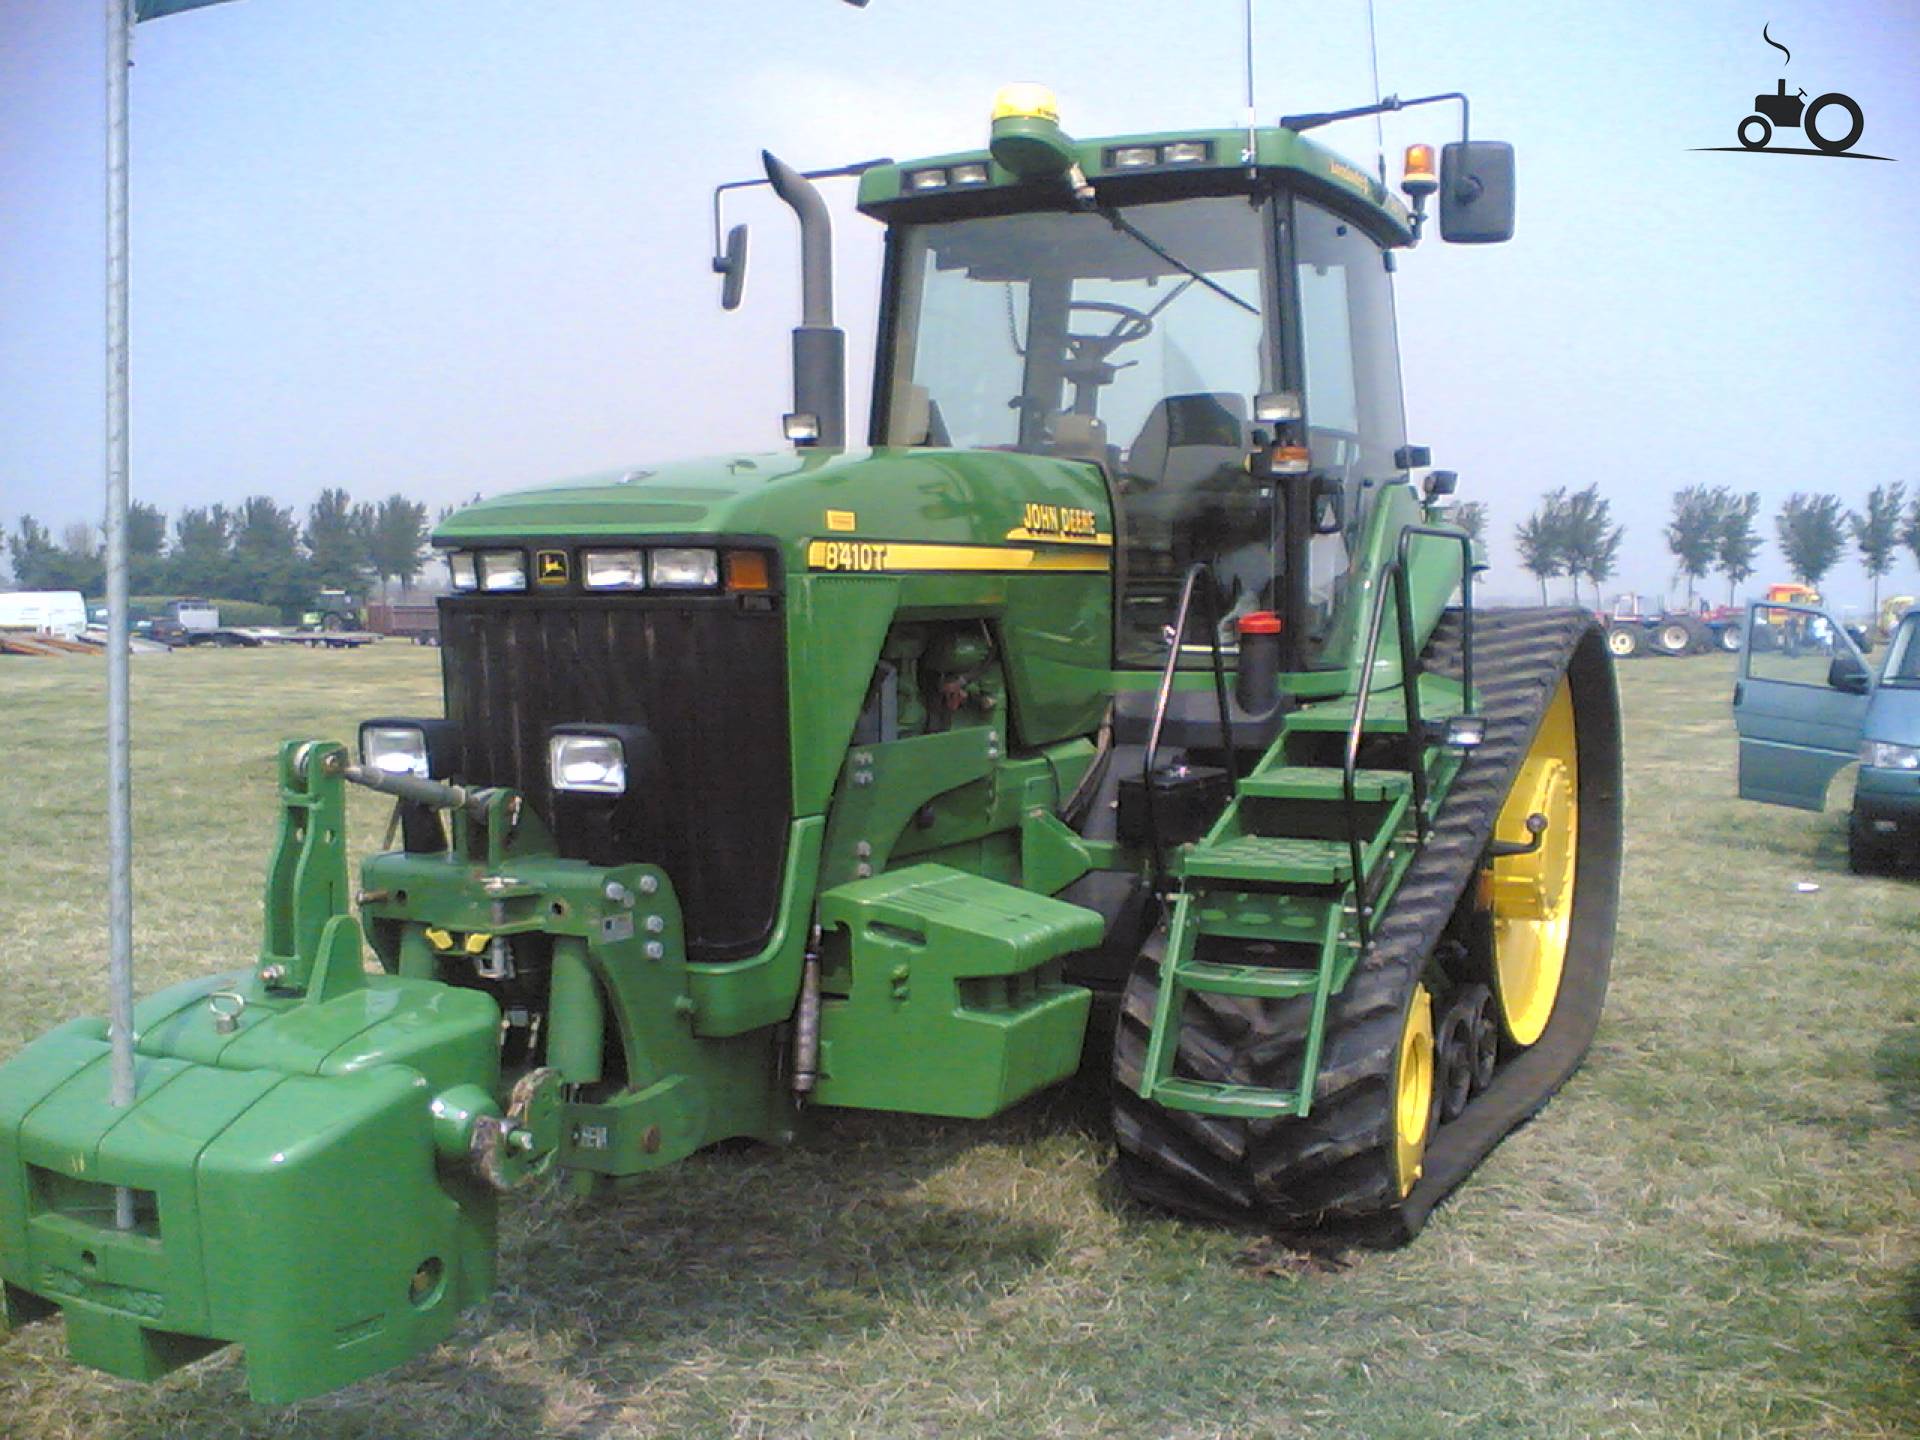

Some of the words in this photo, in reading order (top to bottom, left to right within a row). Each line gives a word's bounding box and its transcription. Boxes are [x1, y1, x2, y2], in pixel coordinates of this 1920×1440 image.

[1023, 502, 1059, 530] JOHN
[1060, 506, 1097, 535] DEERE
[826, 541, 885, 571] 8410T
